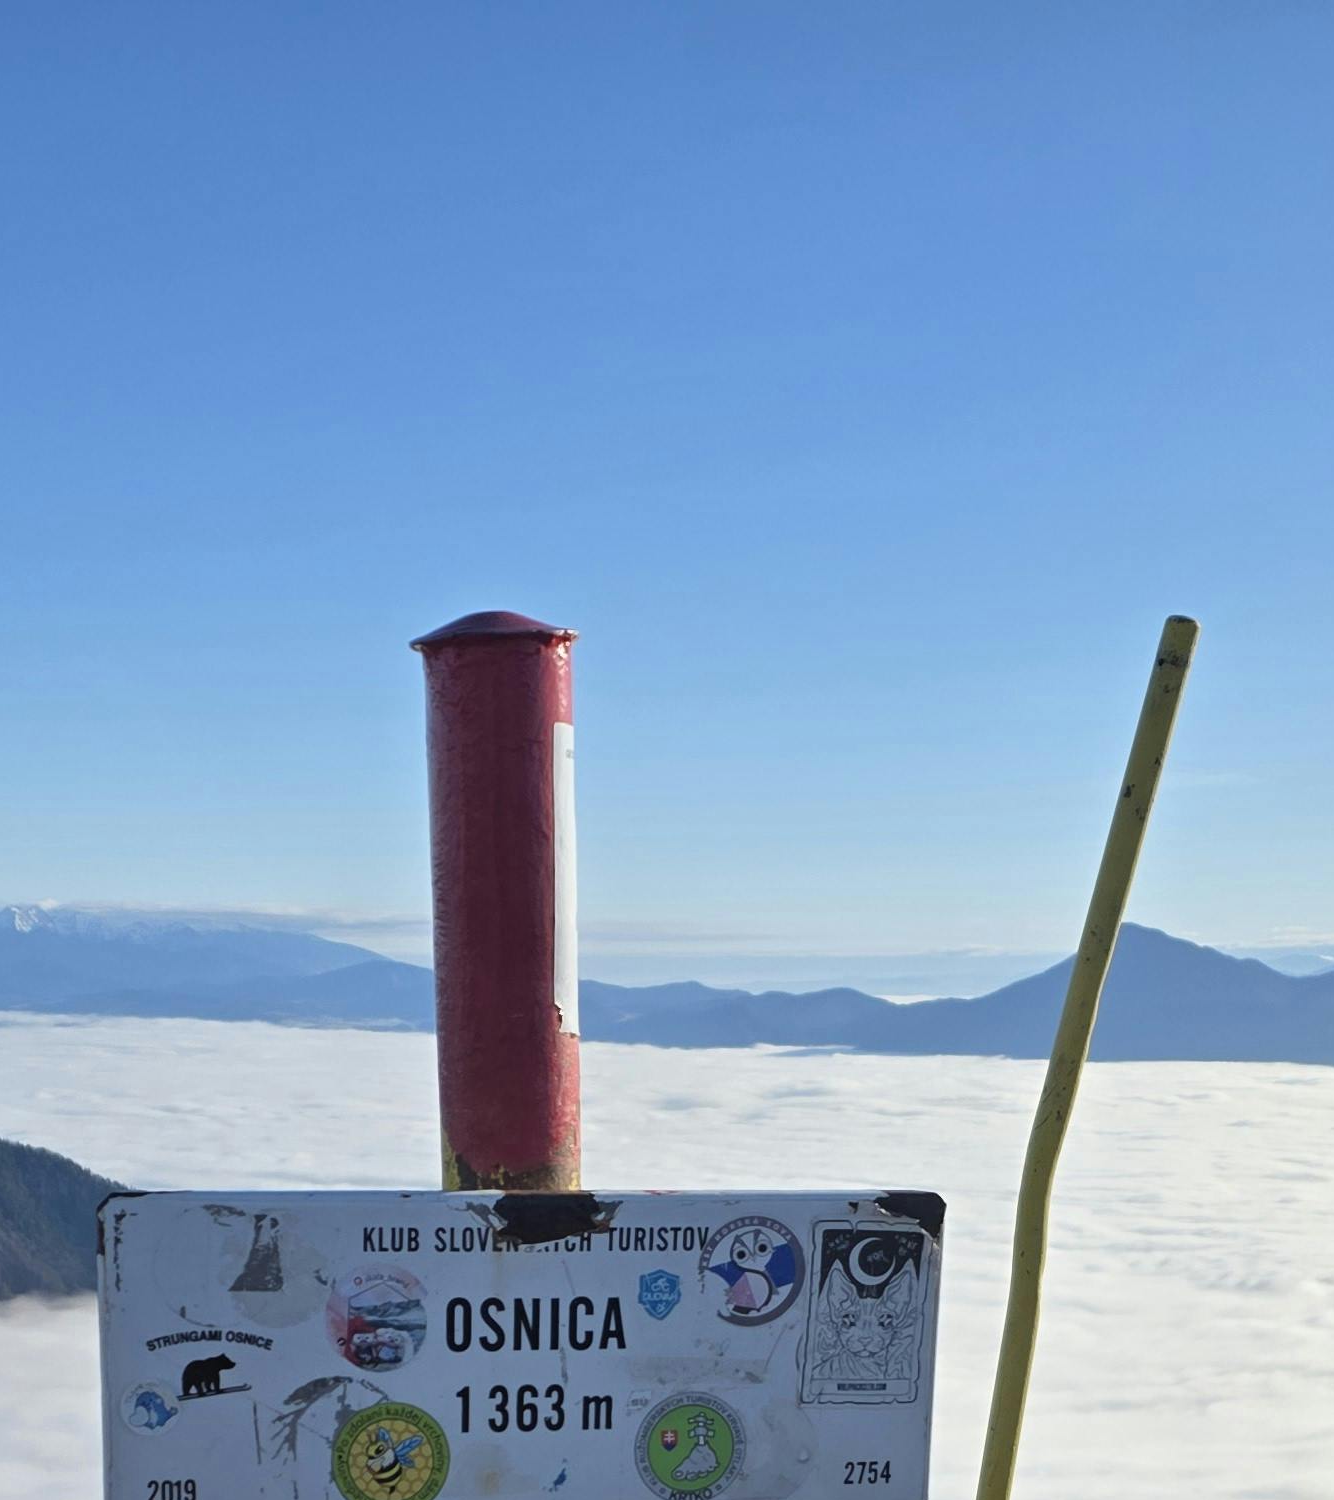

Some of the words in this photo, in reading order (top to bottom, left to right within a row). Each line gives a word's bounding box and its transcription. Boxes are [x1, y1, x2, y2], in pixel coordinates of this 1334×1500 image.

[363, 1227, 420, 1252] KLUB
[608, 1226, 710, 1252] TURISTOV
[446, 1296, 626, 1352] OSNICA
[145, 1330, 223, 1352] STRUNGAMI
[225, 1330, 274, 1351] OSNICE
[582, 1395, 613, 1430] m
[843, 1461, 892, 1485] 2754
